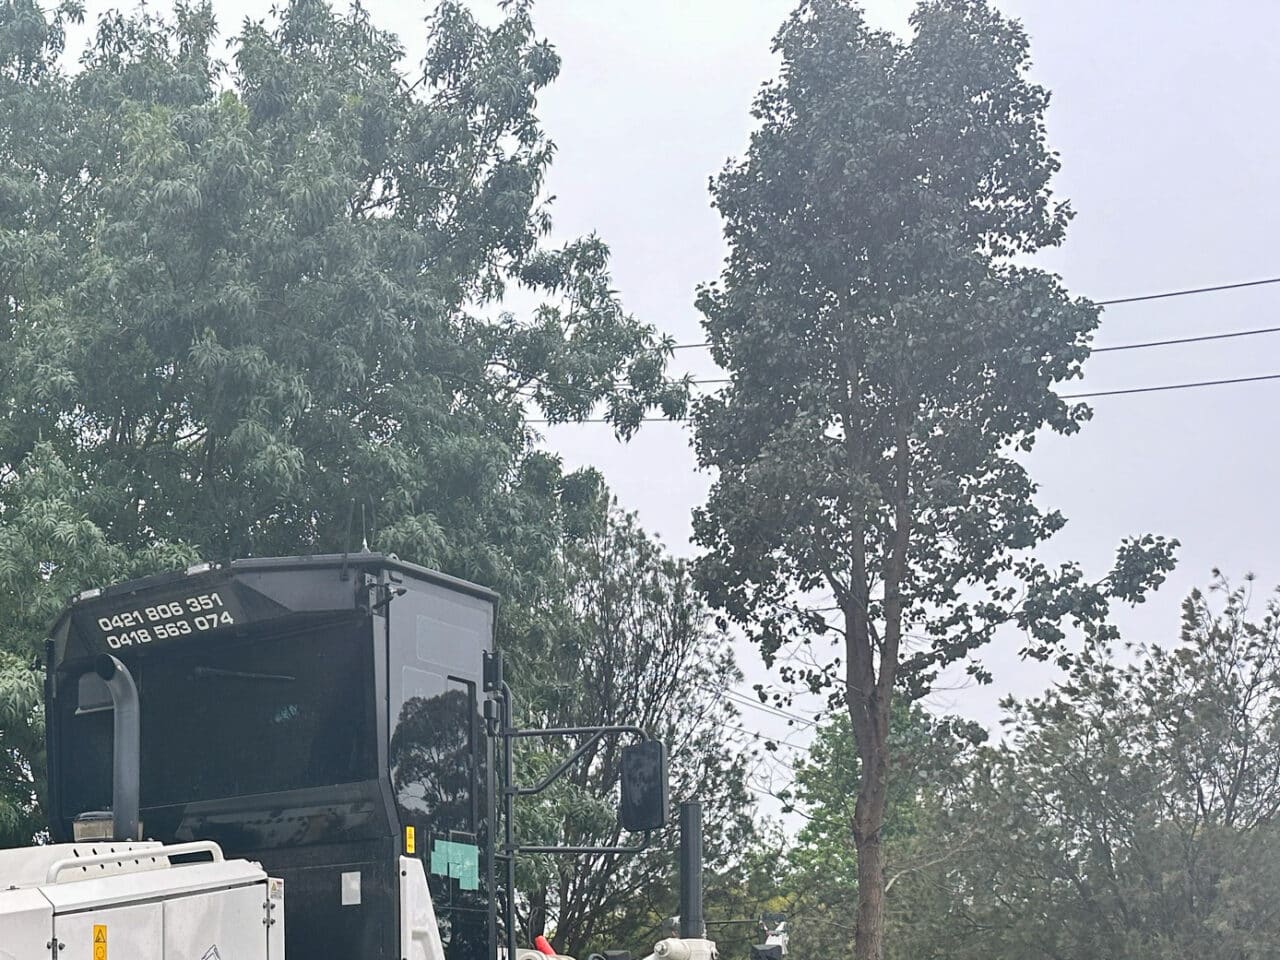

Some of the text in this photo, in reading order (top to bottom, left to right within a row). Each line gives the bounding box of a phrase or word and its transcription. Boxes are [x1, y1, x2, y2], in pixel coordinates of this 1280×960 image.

[98, 592, 223, 632] 0421 806 351
[106, 612, 234, 649] 0418 563 074
